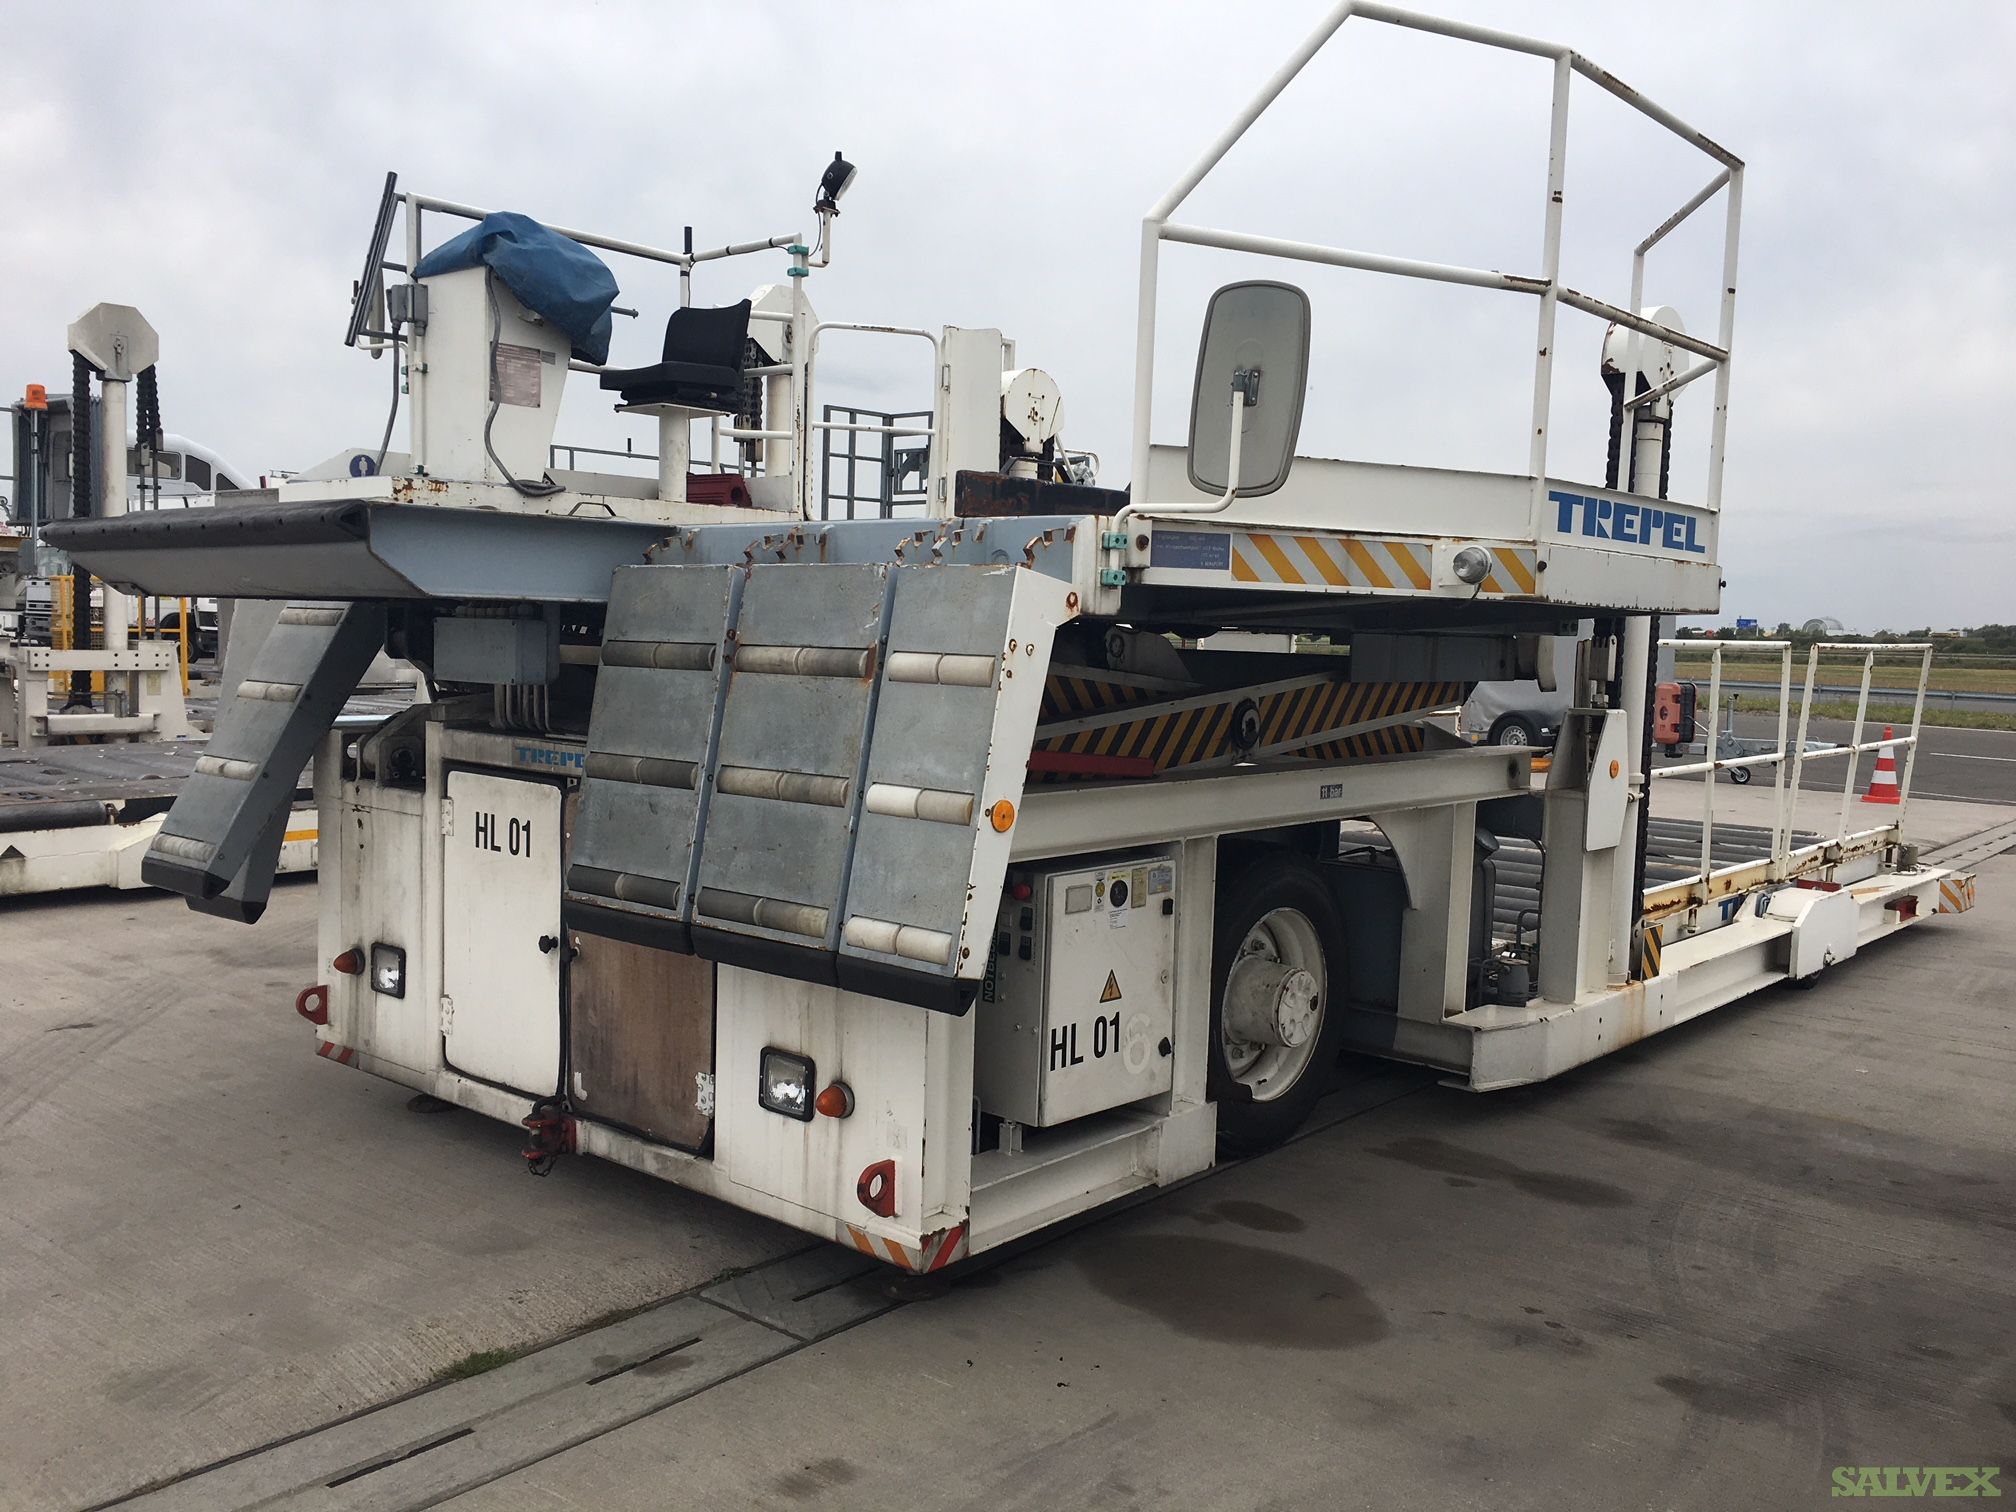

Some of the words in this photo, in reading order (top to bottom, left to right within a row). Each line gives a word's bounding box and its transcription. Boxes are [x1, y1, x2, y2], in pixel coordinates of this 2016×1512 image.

[1548, 490, 1706, 554] TREPEL
[515, 746, 585, 768] TREPE
[1330, 786, 1343, 798] bar
[475, 811, 502, 853] HL
[508, 817, 531, 858] 01
[1050, 1022, 1084, 1072] HL
[1093, 1011, 1120, 1059] 01
